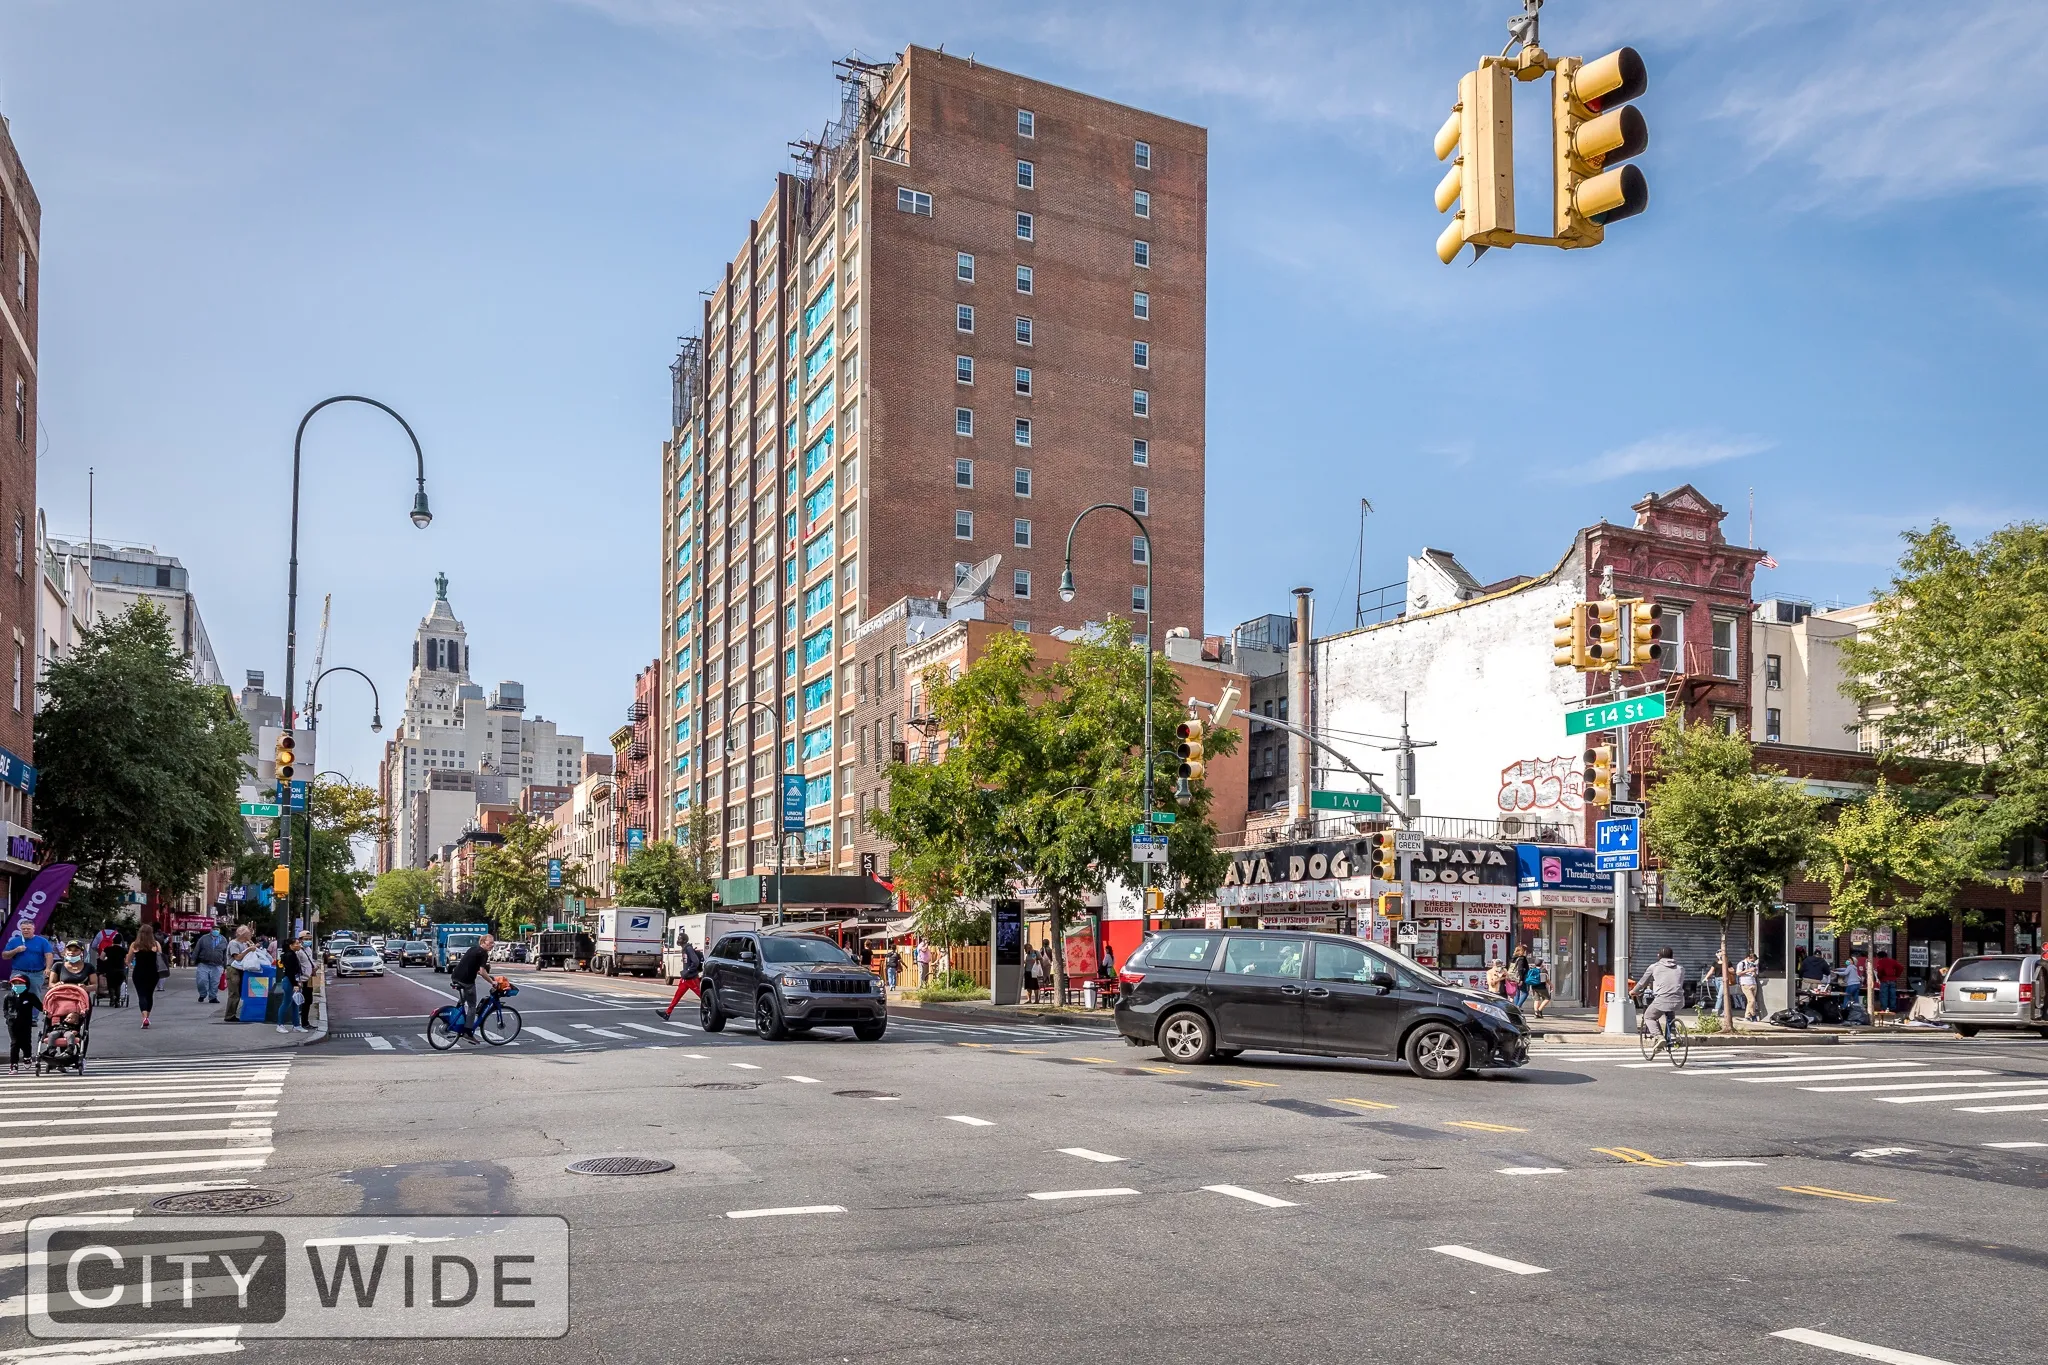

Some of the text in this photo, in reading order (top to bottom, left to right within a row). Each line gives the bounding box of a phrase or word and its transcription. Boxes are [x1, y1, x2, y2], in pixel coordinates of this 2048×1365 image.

[1585, 703, 1644, 727] E 14 St
[1333, 796, 1360, 808] 1 Av
[250, 805, 255, 815] 1
[1398, 833, 1421, 841] DELAYED
[1600, 824, 1633, 845] HOSPITAL
[12, 837, 35, 862] metro
[1398, 841, 1421, 849] GREEN
[1409, 847, 1507, 866] APAYA
[1223, 850, 1350, 887] AYA DOG
[1565, 868, 1611, 882] Threading salon
[1418, 868, 1480, 884] DOG
[1311, 915, 1325, 923] OPEN
[1795, 923, 1808, 931] PLAY
